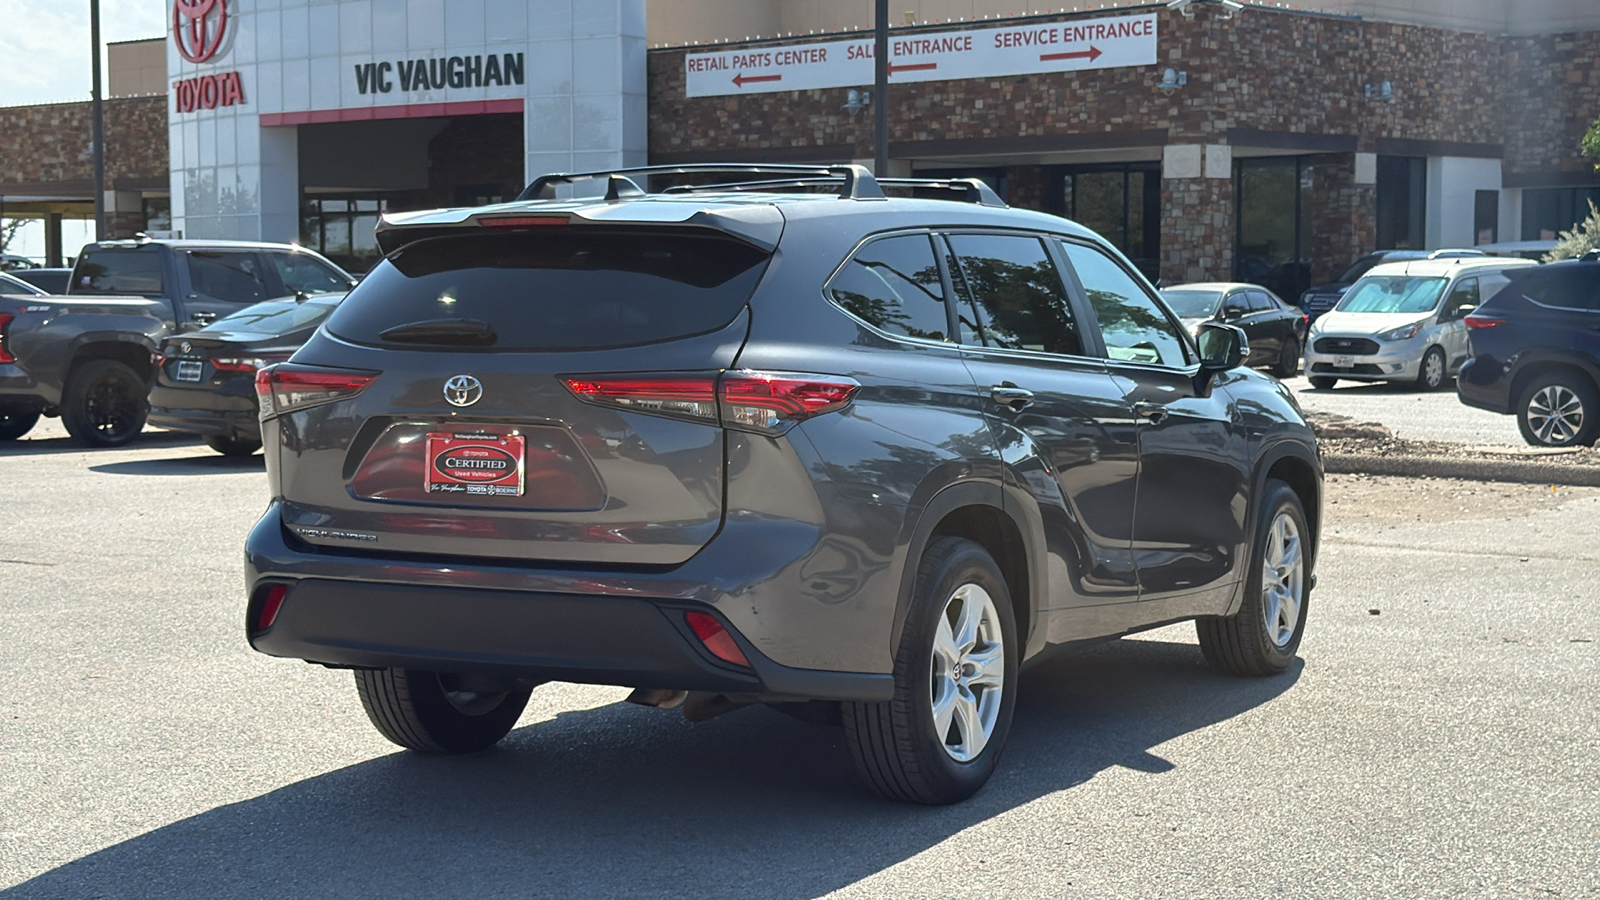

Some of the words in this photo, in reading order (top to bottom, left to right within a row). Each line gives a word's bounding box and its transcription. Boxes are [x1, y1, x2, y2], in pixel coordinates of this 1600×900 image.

[994, 28, 1058, 49] SERVICE
[1063, 20, 1153, 43] ENTRANCE
[688, 57, 729, 72] RETAIL
[732, 53, 771, 69] PARTS
[775, 48, 827, 66] CENTER
[847, 44, 877, 60] SAL
[893, 36, 972, 56] ENTRANCE
[354, 61, 392, 94] VIC
[397, 53, 524, 92] VAUGHAN
[173, 71, 245, 113] TOYOTA
[445, 457, 507, 469] CERTIFIED
